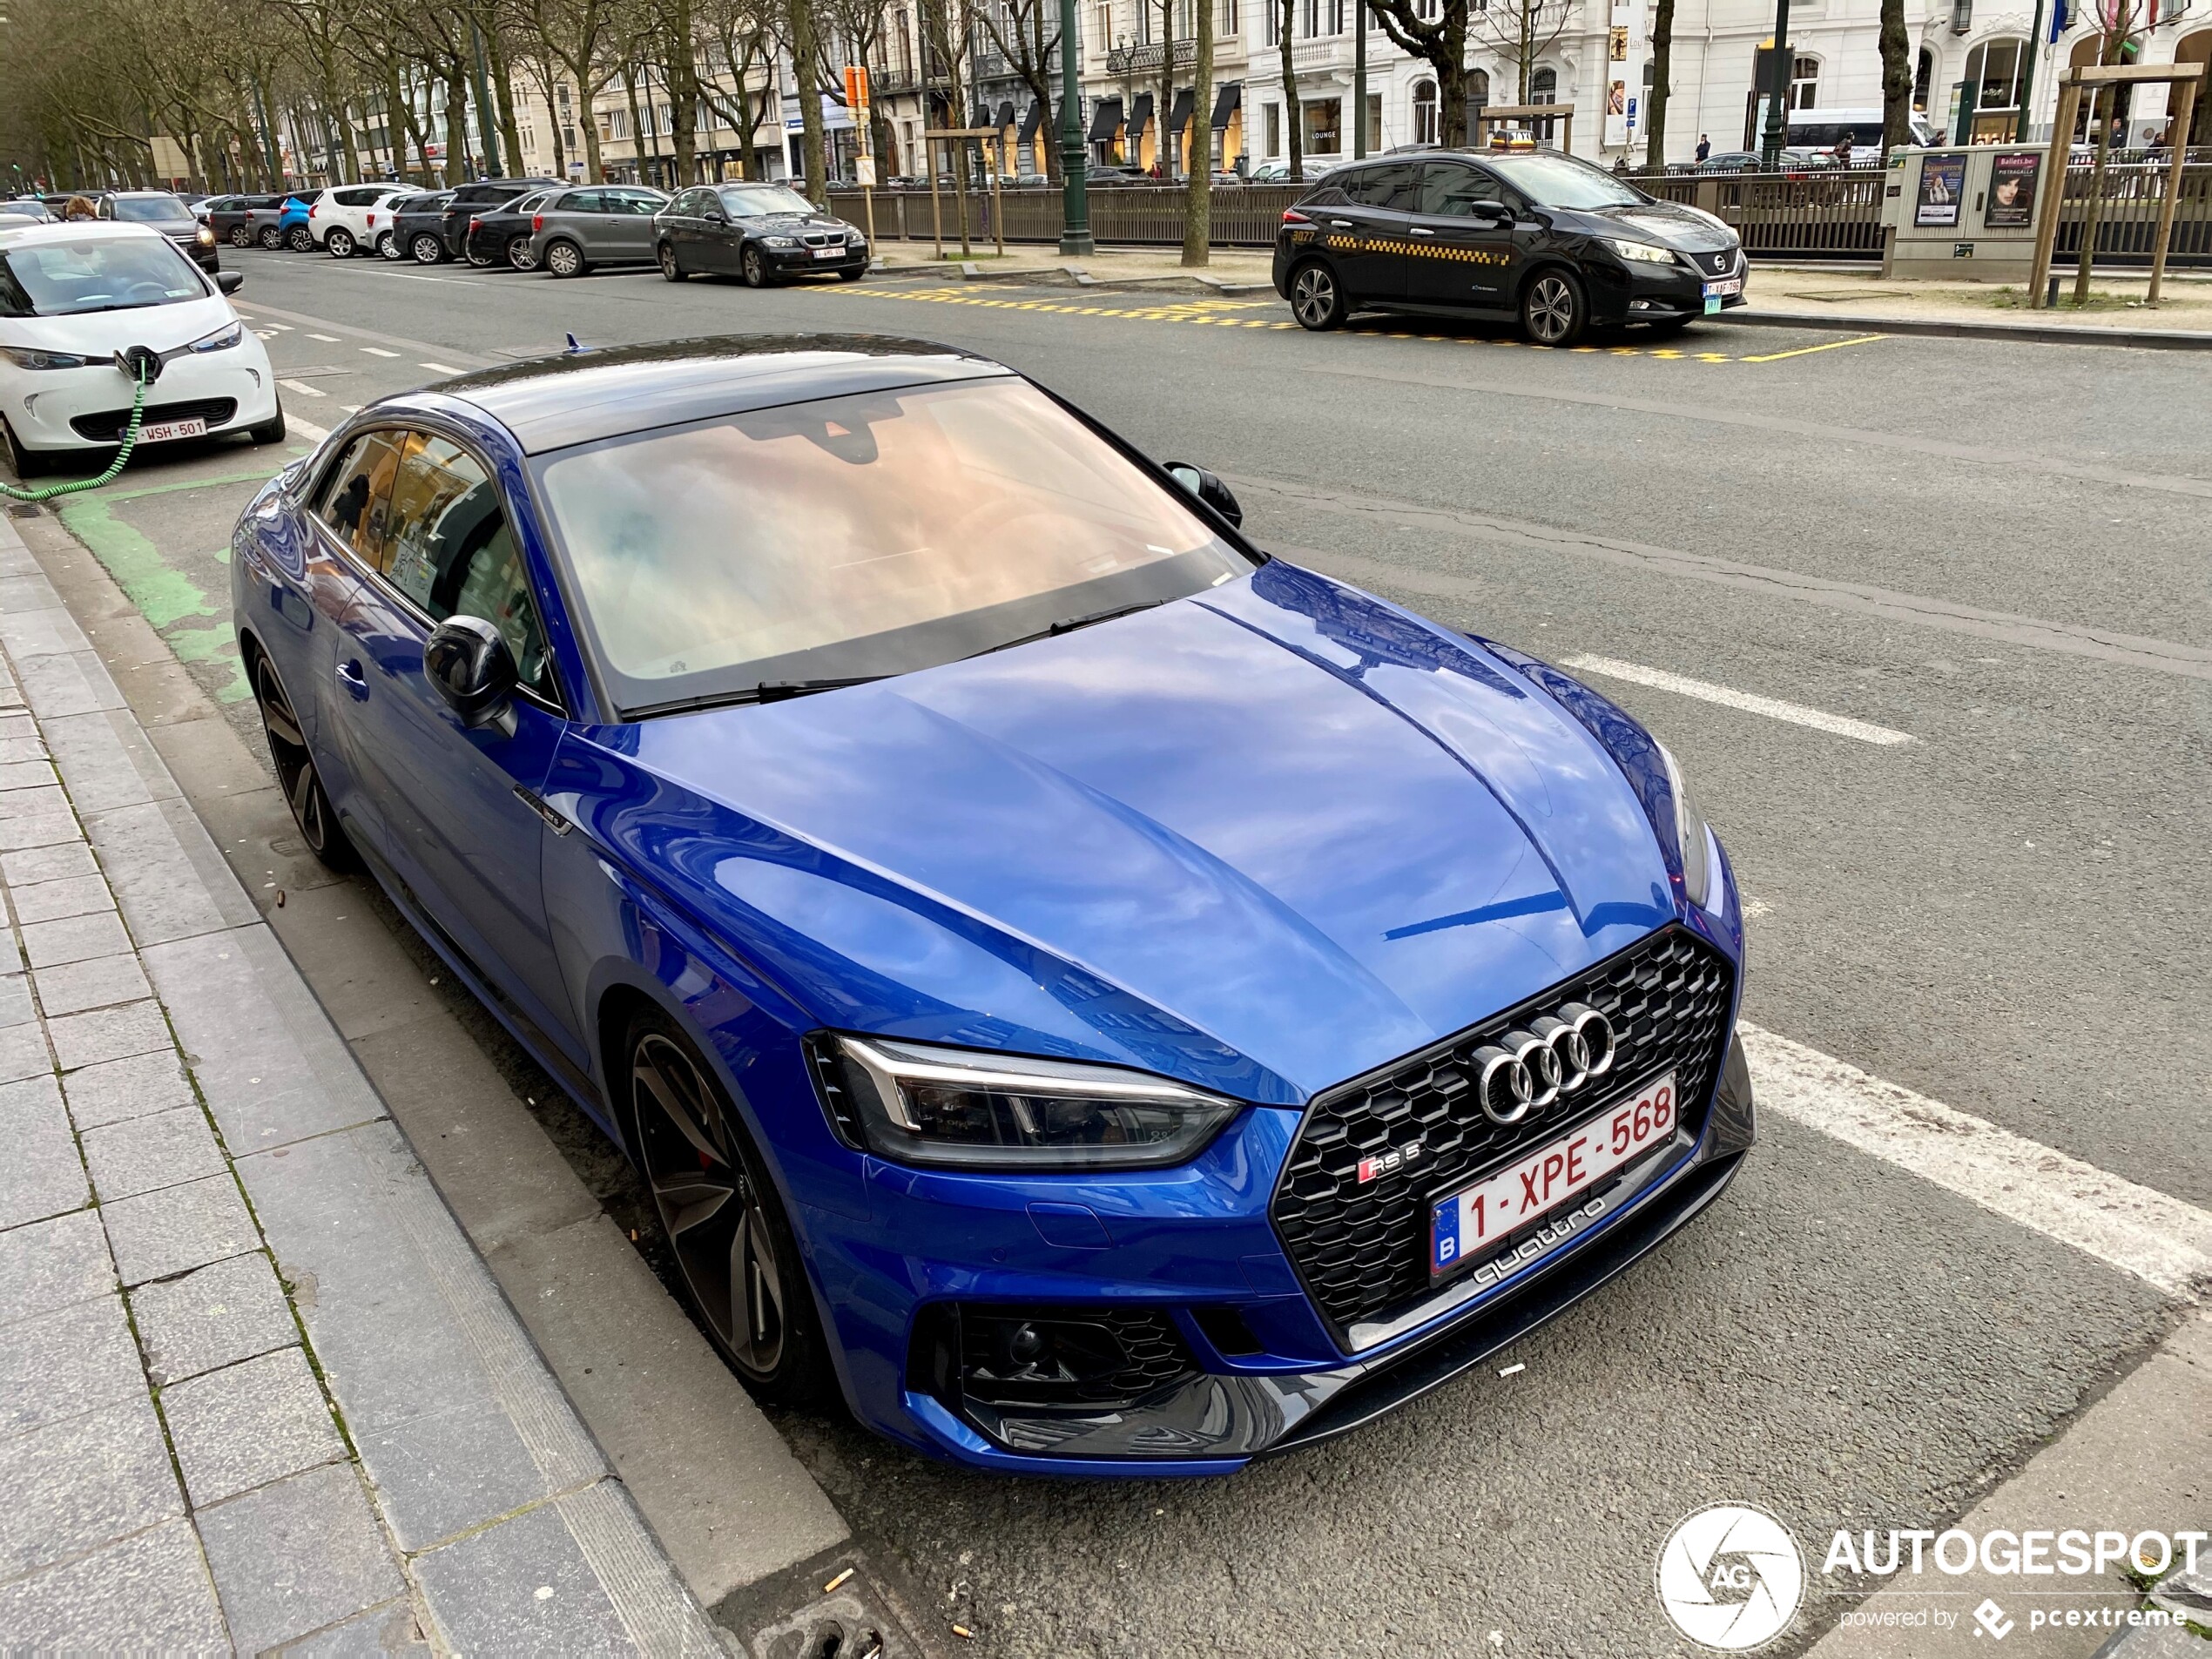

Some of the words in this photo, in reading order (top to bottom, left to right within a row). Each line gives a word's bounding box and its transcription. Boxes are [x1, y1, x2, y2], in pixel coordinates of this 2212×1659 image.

[1312, 131, 1336, 139] LOUNGE
[1511, 132, 1532, 142] TAXI
[1292, 230, 1315, 242] 3077
[134, 422, 203, 442] -WSH-501
[1368, 1152, 1400, 1177] RS
[1406, 1143, 1420, 1161] 5
[1471, 1086, 1671, 1238] 1-XPE-568
[1440, 1236, 1455, 1261] B
[1474, 1197, 1606, 1285] quattro
